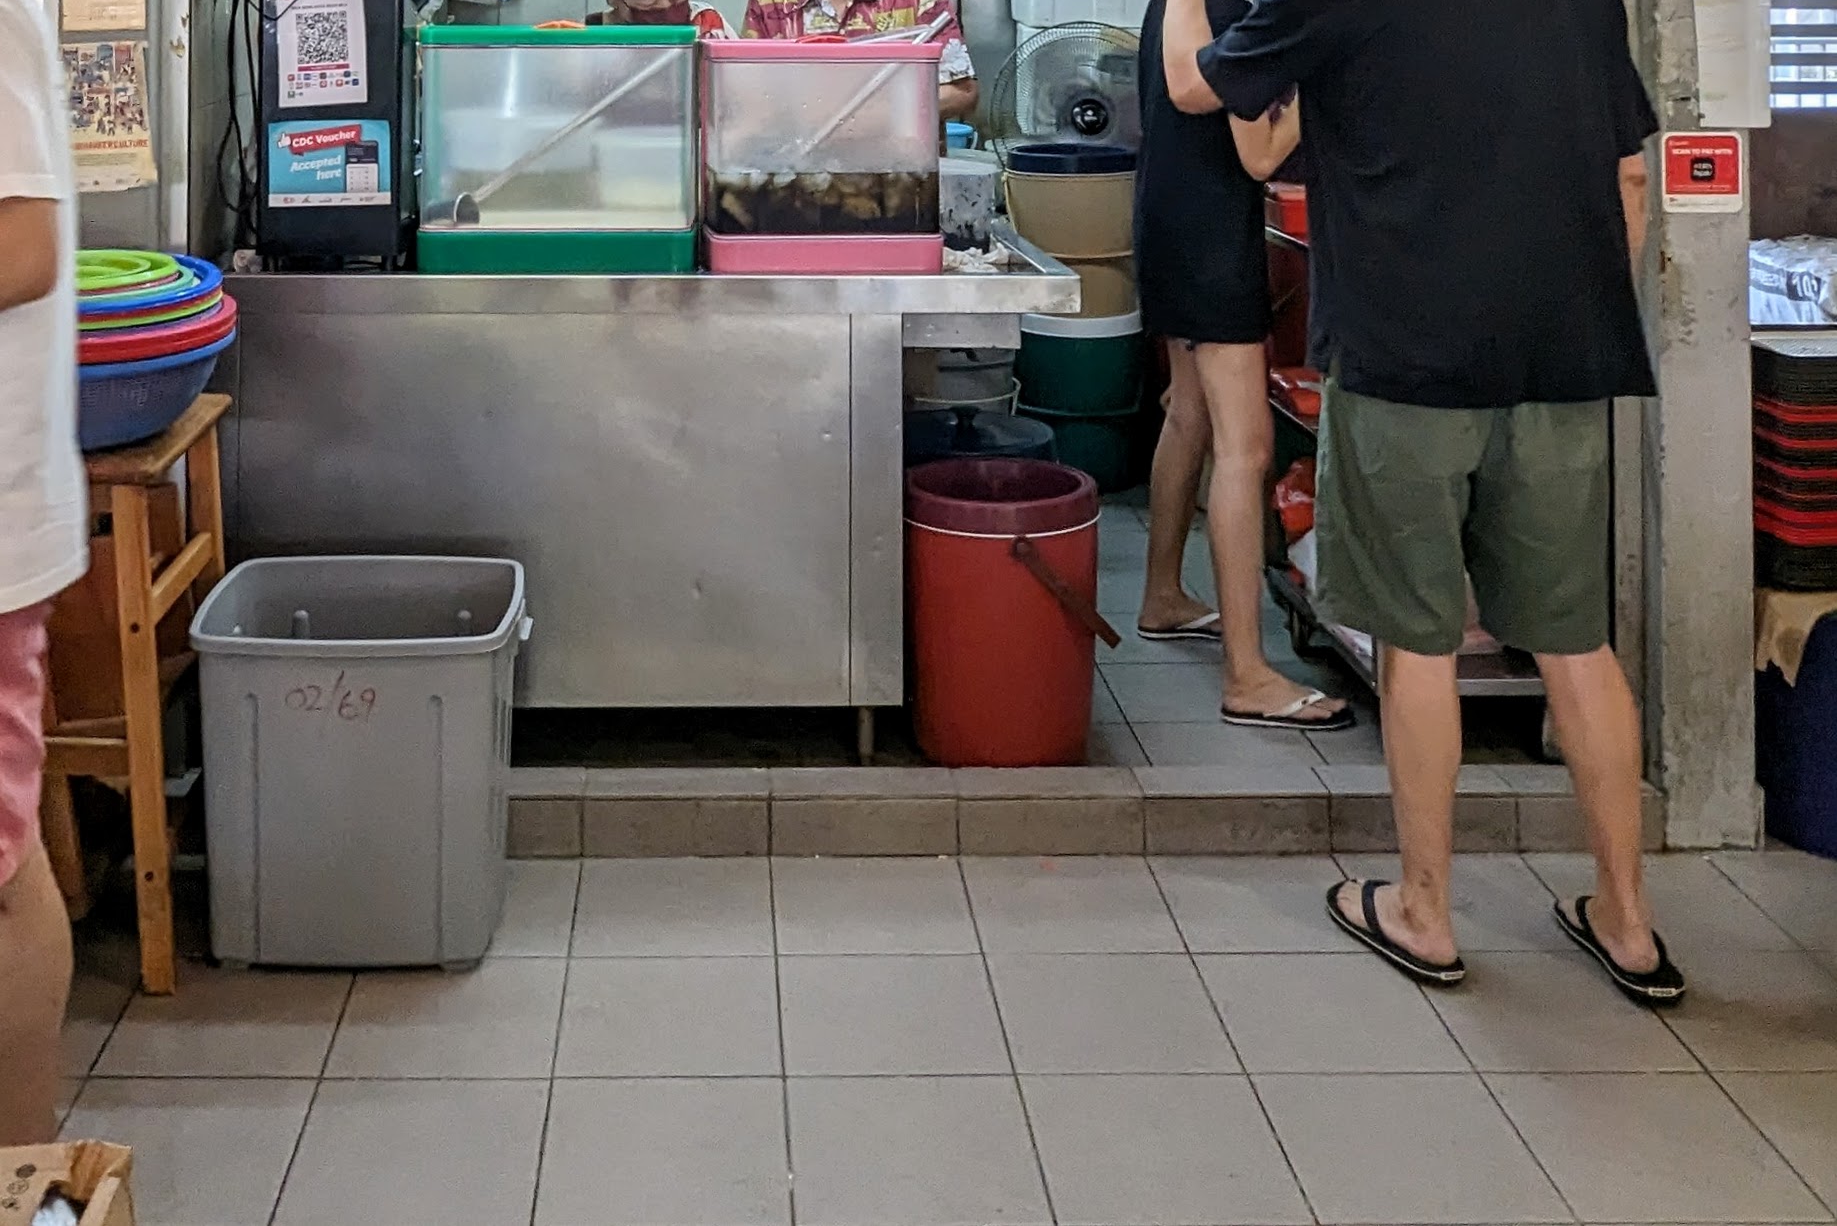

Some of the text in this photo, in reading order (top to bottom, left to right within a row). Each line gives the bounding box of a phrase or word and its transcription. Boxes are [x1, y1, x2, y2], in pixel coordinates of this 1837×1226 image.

[292, 130, 357, 148] CDC Voucher
[290, 155, 342, 172] Accepted
[316, 168, 343, 181] here
[285, 670, 376, 721] 02/69
